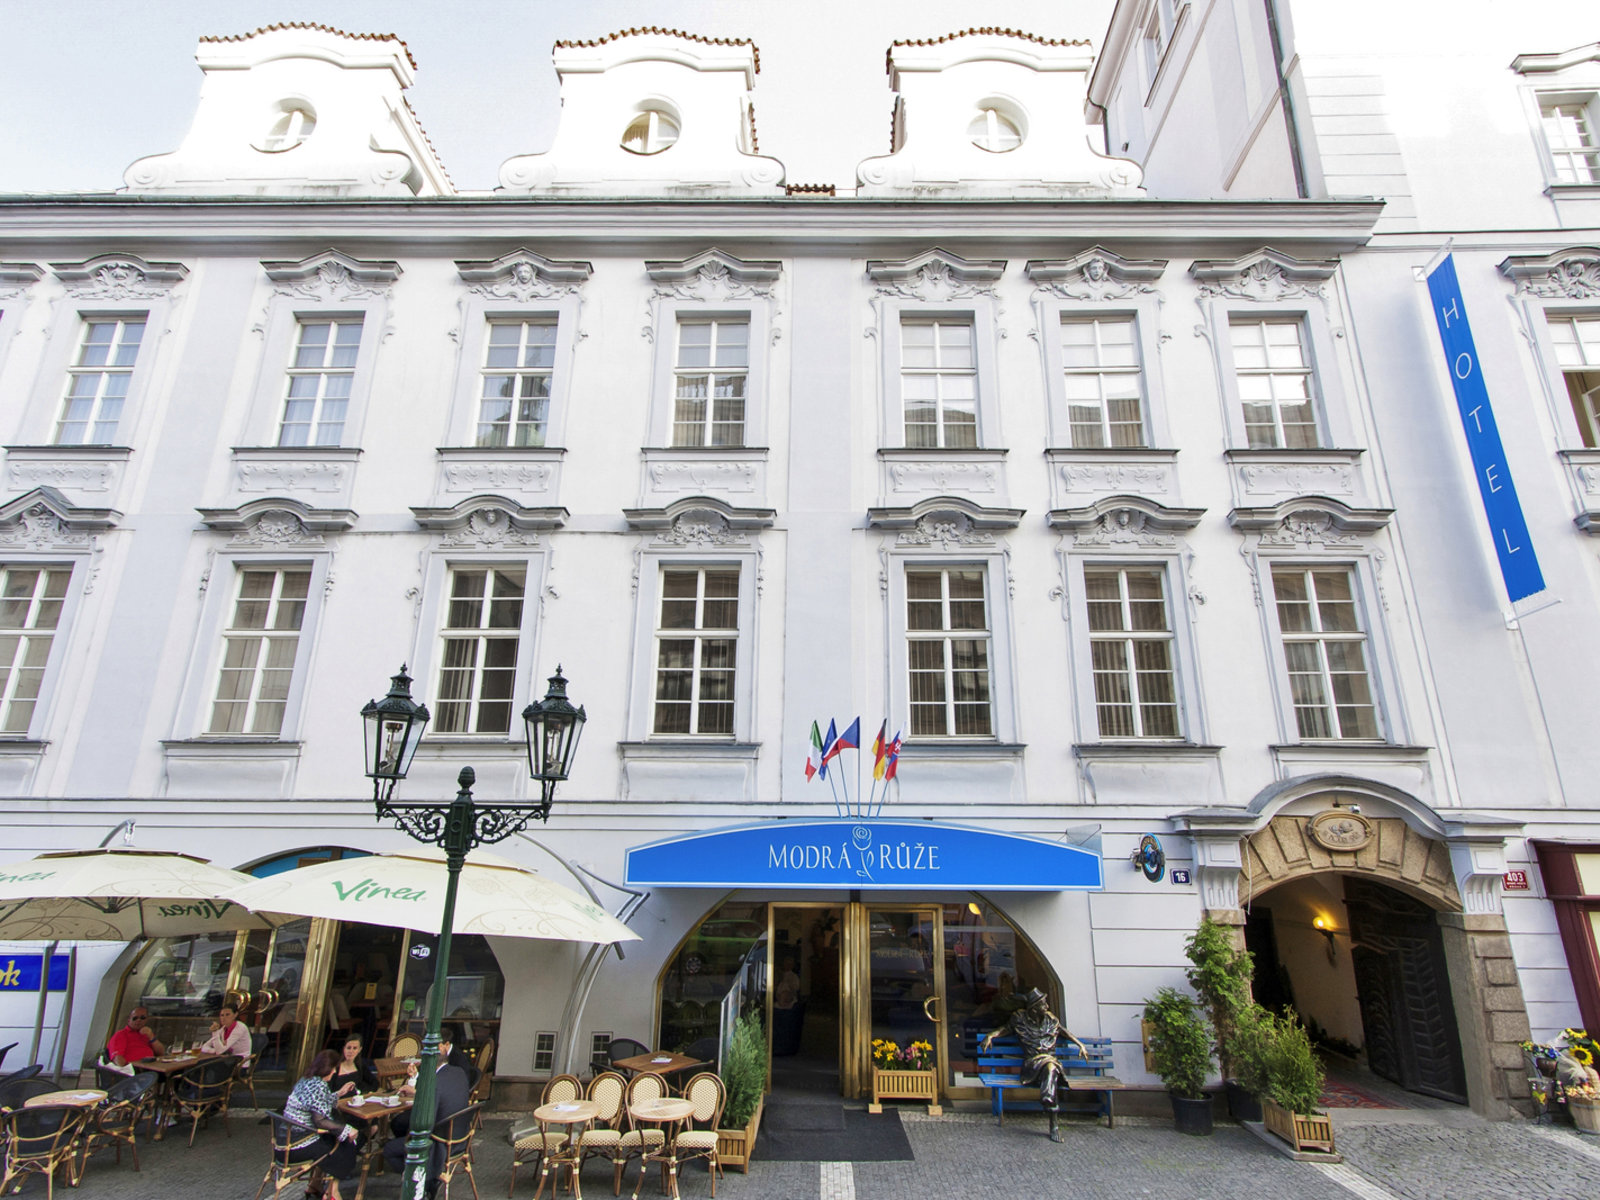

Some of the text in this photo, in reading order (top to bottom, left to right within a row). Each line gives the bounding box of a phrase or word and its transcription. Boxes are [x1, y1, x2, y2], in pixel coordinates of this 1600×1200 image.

[1442, 297, 1521, 554] HOTEL
[768, 841, 941, 870] MODRÁ RŮŽE
[1175, 872, 1186, 882] 16
[1507, 872, 1524, 882] 403
[331, 878, 427, 902] Vinea
